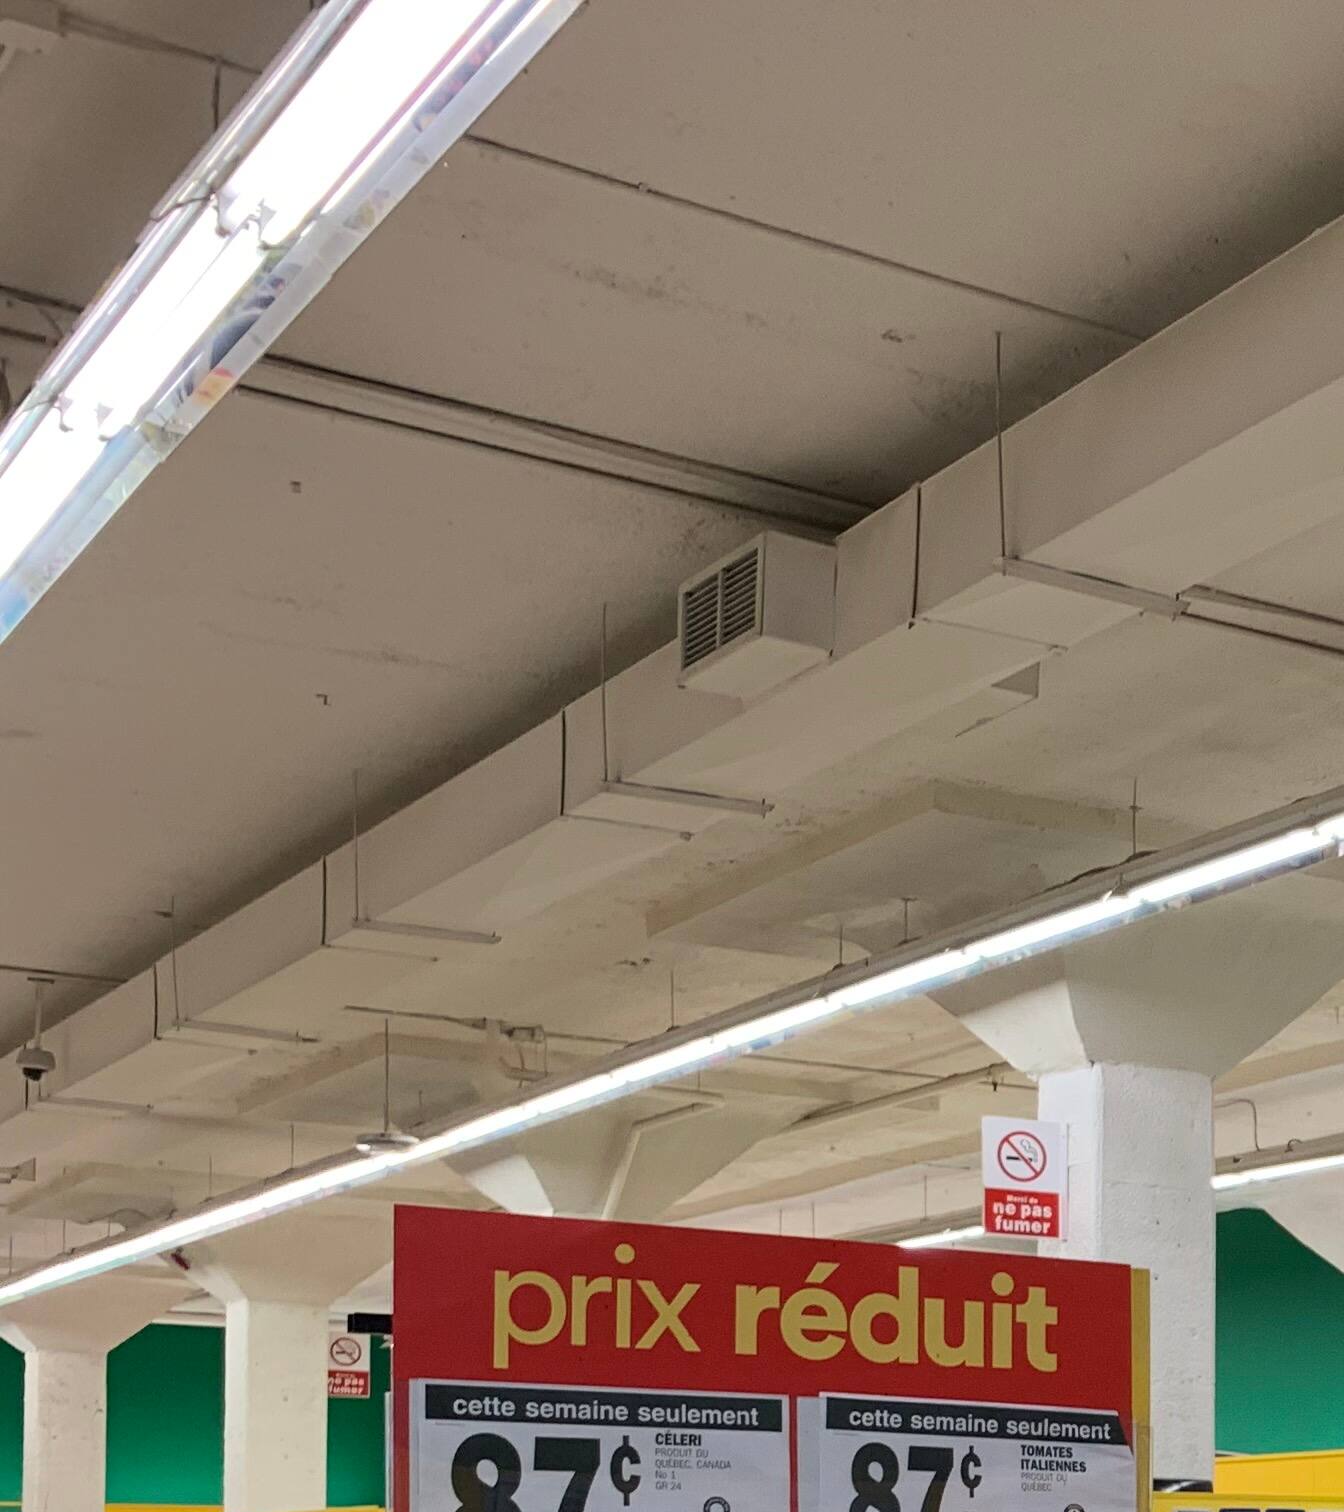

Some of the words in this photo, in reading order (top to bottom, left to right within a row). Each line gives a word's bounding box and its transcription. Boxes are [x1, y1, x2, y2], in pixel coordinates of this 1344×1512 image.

[992, 1201, 1016, 1215] ne
[1020, 1203, 1053, 1219] pas
[994, 1215, 1052, 1234] fumer
[493, 1243, 701, 1369] prix
[735, 1263, 1058, 1374] réduit
[453, 1397, 515, 1418] cette
[525, 1400, 629, 1422] semaine
[638, 1402, 759, 1426] seulement
[849, 1409, 903, 1428] cette
[910, 1413, 999, 1434] semaine
[1006, 1418, 1111, 1440] seulement
[655, 1431, 703, 1447] CÉLERI
[655, 1448, 691, 1458] PRODUIT
[695, 1449, 709, 1459] DU
[1020, 1444, 1073, 1459] TOMATES
[696, 1460, 732, 1470] CANADA
[1020, 1459, 1087, 1473] ITALIENNES
